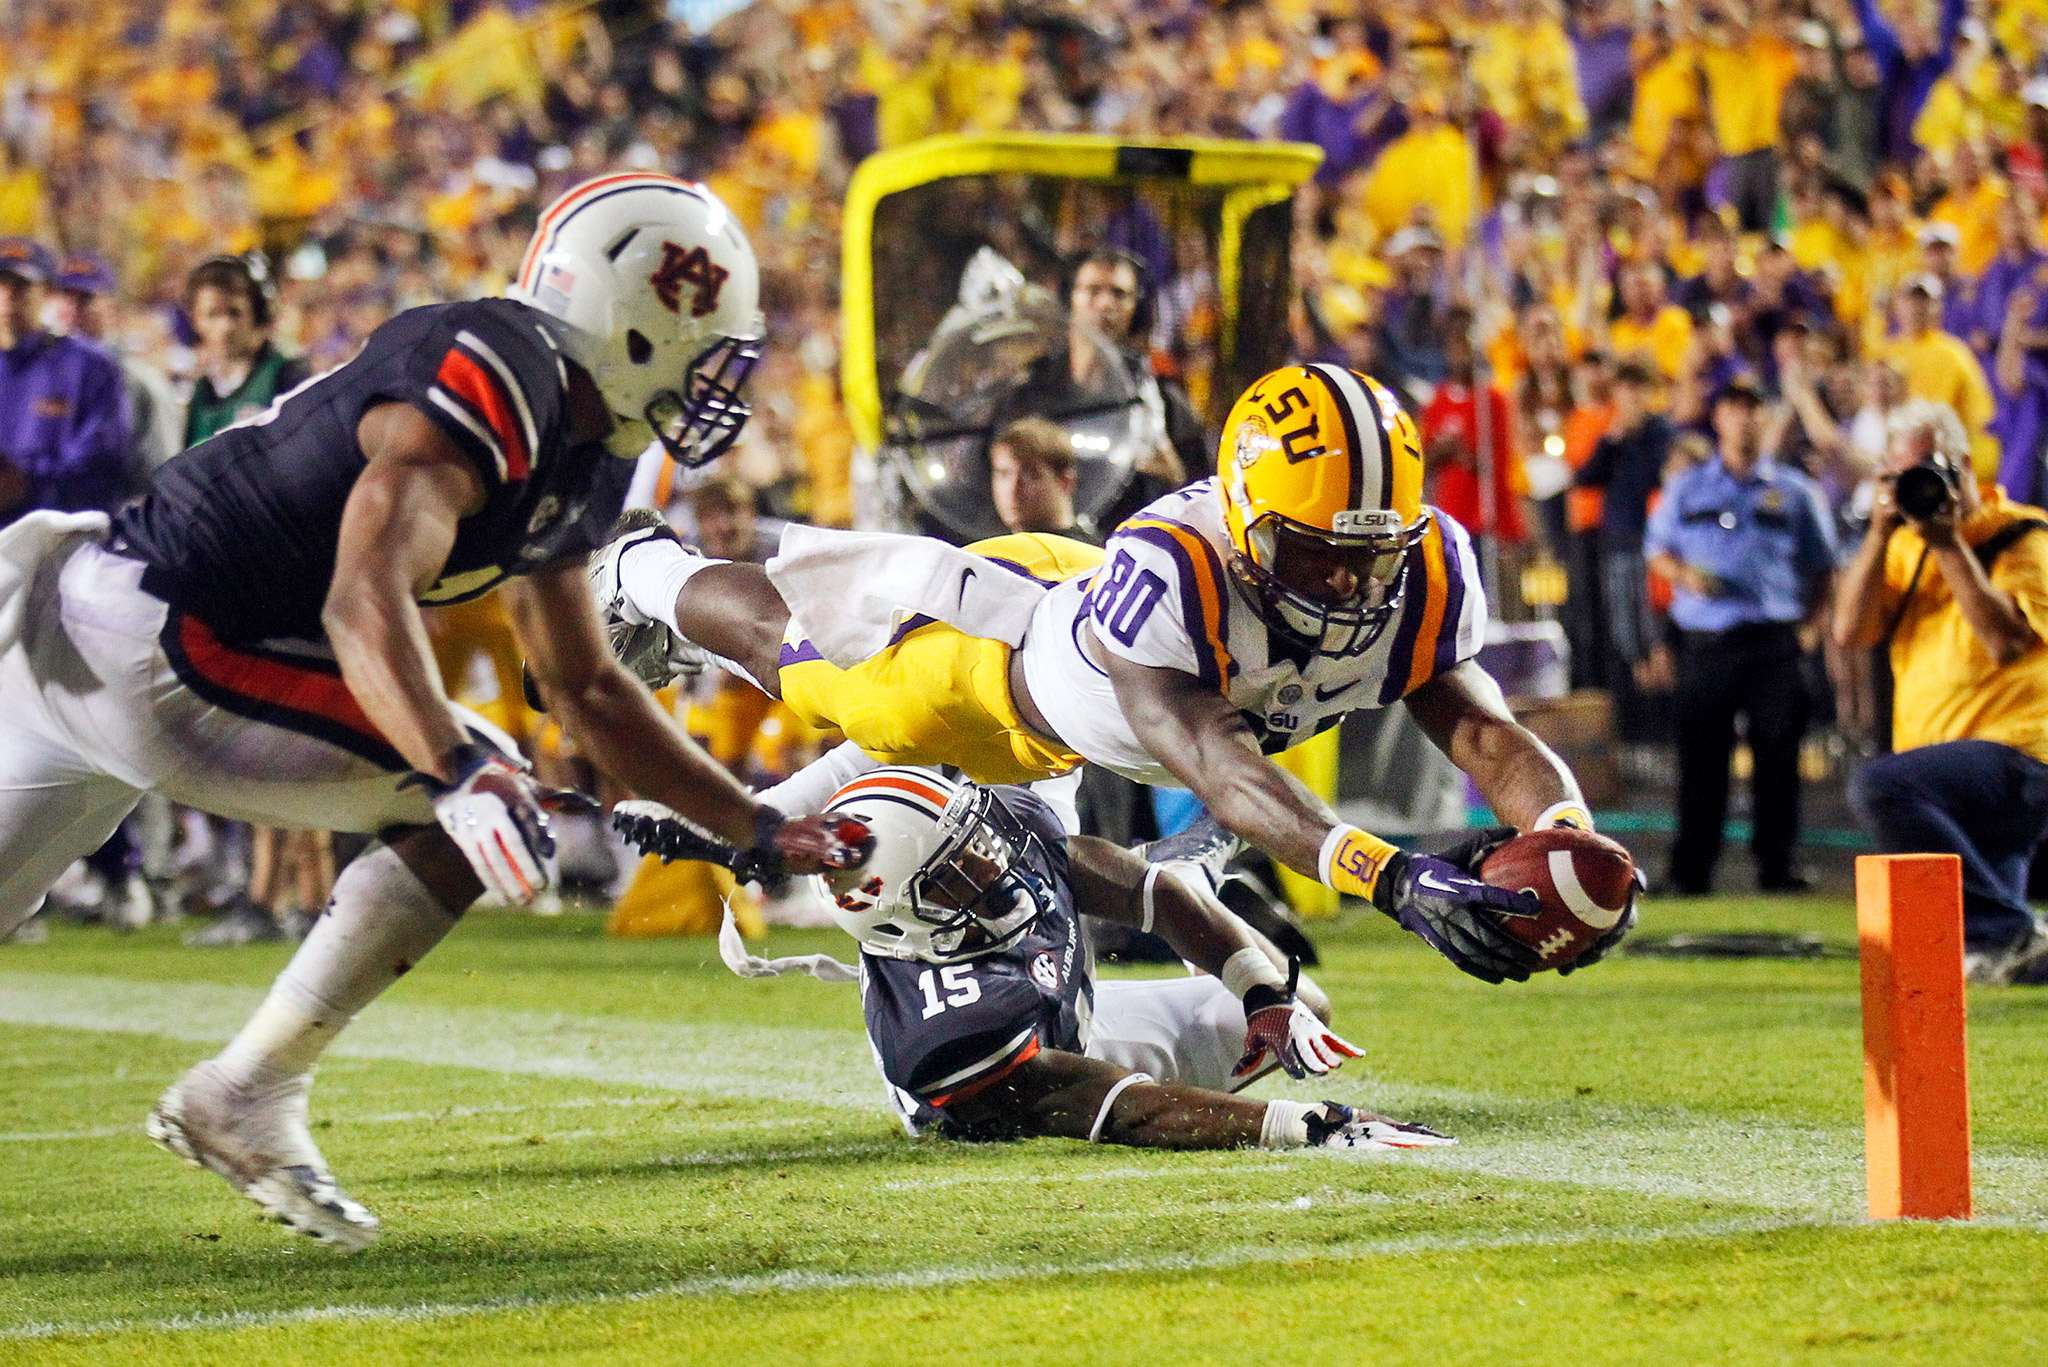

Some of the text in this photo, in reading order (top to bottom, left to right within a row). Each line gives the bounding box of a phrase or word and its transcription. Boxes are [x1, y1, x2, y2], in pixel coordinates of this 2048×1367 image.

[1353, 514, 1388, 526] LSU
[1095, 548, 1168, 649] 80
[1269, 712, 1299, 731] SU
[1337, 839, 1379, 883] LSU
[1061, 917, 1077, 985] AUBURN
[918, 963, 982, 1021] 15
